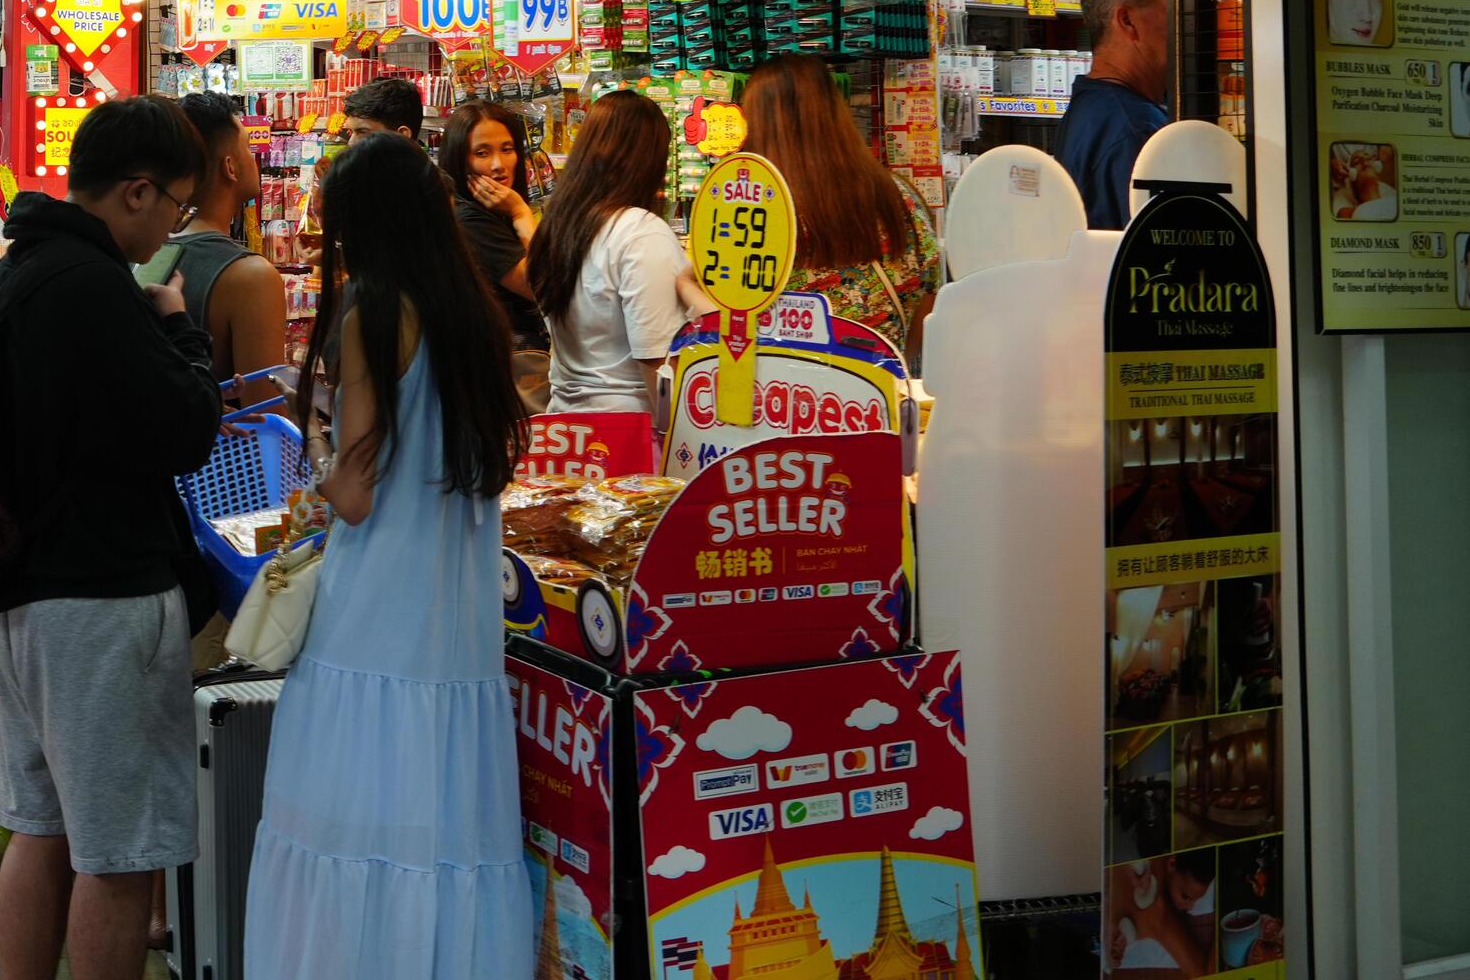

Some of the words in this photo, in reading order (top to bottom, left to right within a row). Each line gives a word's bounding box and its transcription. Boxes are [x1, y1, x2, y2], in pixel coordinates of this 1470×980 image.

[57, 10, 120, 21] WHOLESALE
[293, 2, 338, 18] VISA
[74, 22, 103, 32] PRICE
[1326, 61, 1364, 74] BUBBLES
[1366, 63, 1391, 75] MASK
[1407, 62, 1427, 78] 650
[1331, 86, 1359, 99] Oxygen
[1361, 87, 1385, 97] Bubble
[1387, 88, 1403, 98] Face
[1405, 89, 1423, 100] Mask
[1425, 90, 1442, 102] Deep
[989, 99, 1035, 112] Favorites
[1332, 100, 1370, 111] Purification
[1372, 101, 1400, 112] Charcoal
[1429, 118, 1443, 128] Skin
[723, 181, 762, 204] SALE
[1150, 229, 1215, 246] WELCOME
[1218, 229, 1235, 246] TO
[1330, 237, 1372, 249] DIAMOND
[1375, 238, 1400, 249] MASK
[1412, 235, 1431, 250] 850
[1332, 268, 1364, 278] Diamond
[1367, 268, 1386, 278] facial
[1388, 269, 1407, 280] helps
[1408, 269, 1416, 278] in
[1417, 269, 1448, 280] reducing
[1128, 263, 1259, 314] Pradara
[1333, 283, 1346, 292] fine
[1348, 283, 1362, 292] lines
[1364, 283, 1376, 292] and
[1424, 283, 1435, 292] the
[1436, 283, 1449, 292] face
[778, 298, 816, 310] THAILAND
[778, 308, 813, 331] 100
[779, 329, 794, 338] BAHT
[1156, 319, 1179, 337] Thai
[1180, 319, 1234, 338] Massage
[1175, 364, 1205, 382] THAI
[1208, 363, 1265, 381] MASSAGE
[685, 368, 887, 433] Capest
[1130, 395, 1187, 408] TRADITIONAL
[1191, 393, 1212, 406] THAI
[1214, 392, 1255, 404] MASSAGE
[528, 423, 594, 455] EST
[513, 460, 606, 480] ELLER
[723, 451, 833, 495] BEST
[707, 496, 847, 545] SELLER
[695, 547, 774, 580] 畅销书
[785, 586, 812, 598] VISA
[508, 673, 595, 788] ELLER
[874, 787, 903, 803] 支付宝
[876, 800, 903, 810] ALIPAY
[715, 807, 770, 835] VISA
